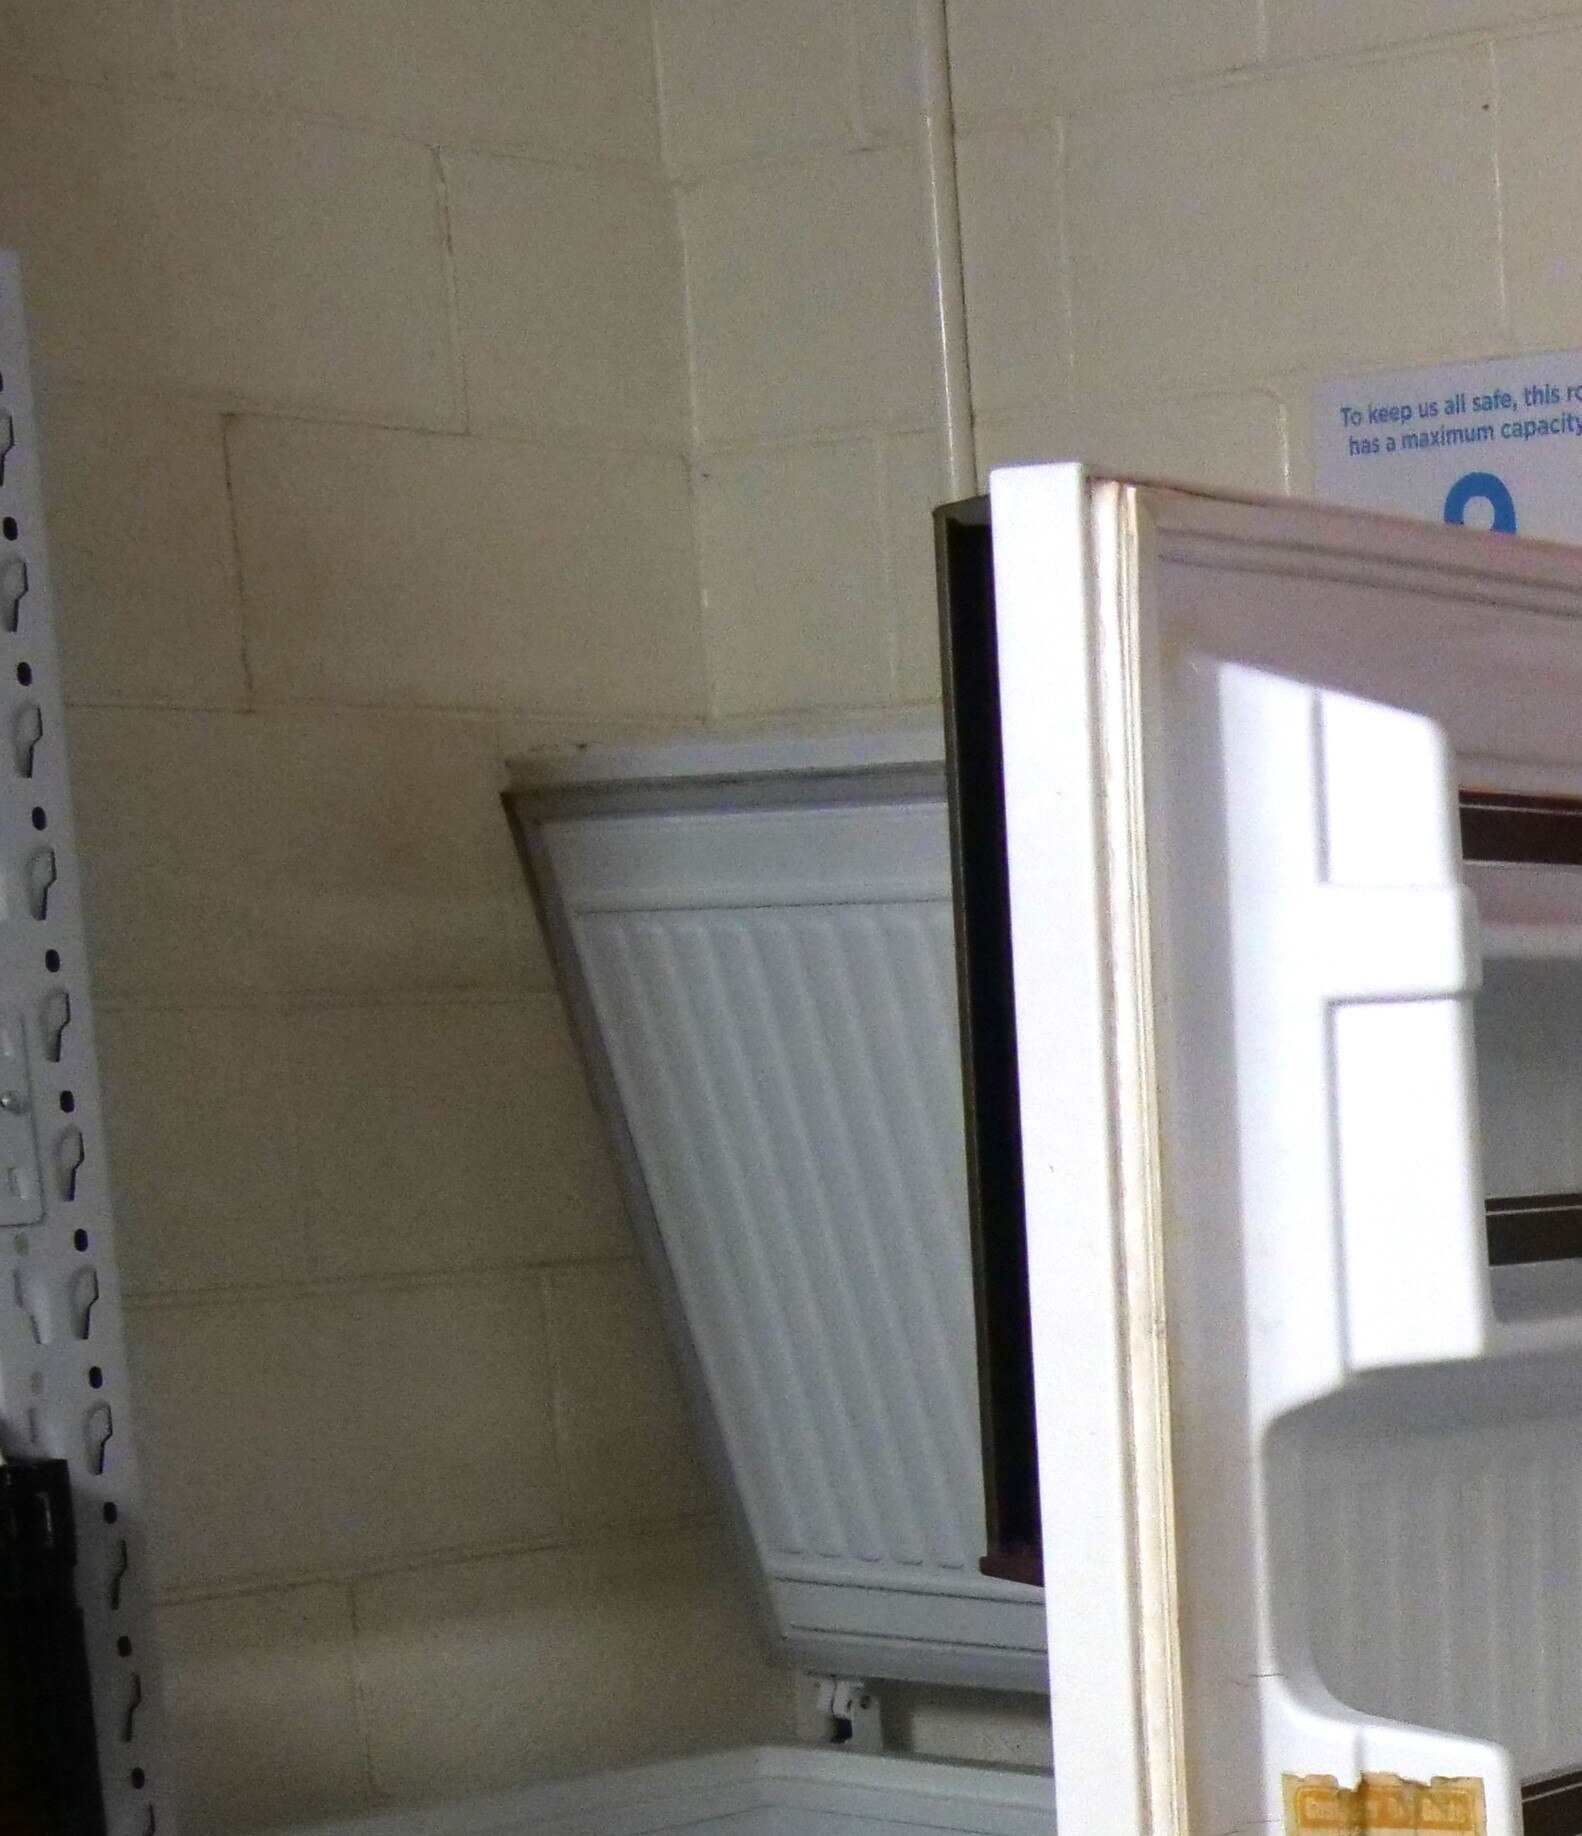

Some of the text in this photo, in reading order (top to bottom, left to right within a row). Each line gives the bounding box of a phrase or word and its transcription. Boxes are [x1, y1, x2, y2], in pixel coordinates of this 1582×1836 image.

[1340, 406, 1363, 428] To
[1368, 402, 1413, 427] keep
[1419, 398, 1438, 418] us
[1444, 394, 1466, 415] all
[1473, 392, 1518, 413] safe,
[1524, 384, 1560, 407] this
[1348, 435, 1379, 456] has
[1386, 434, 1396, 452] a
[1402, 425, 1494, 451] maximum
